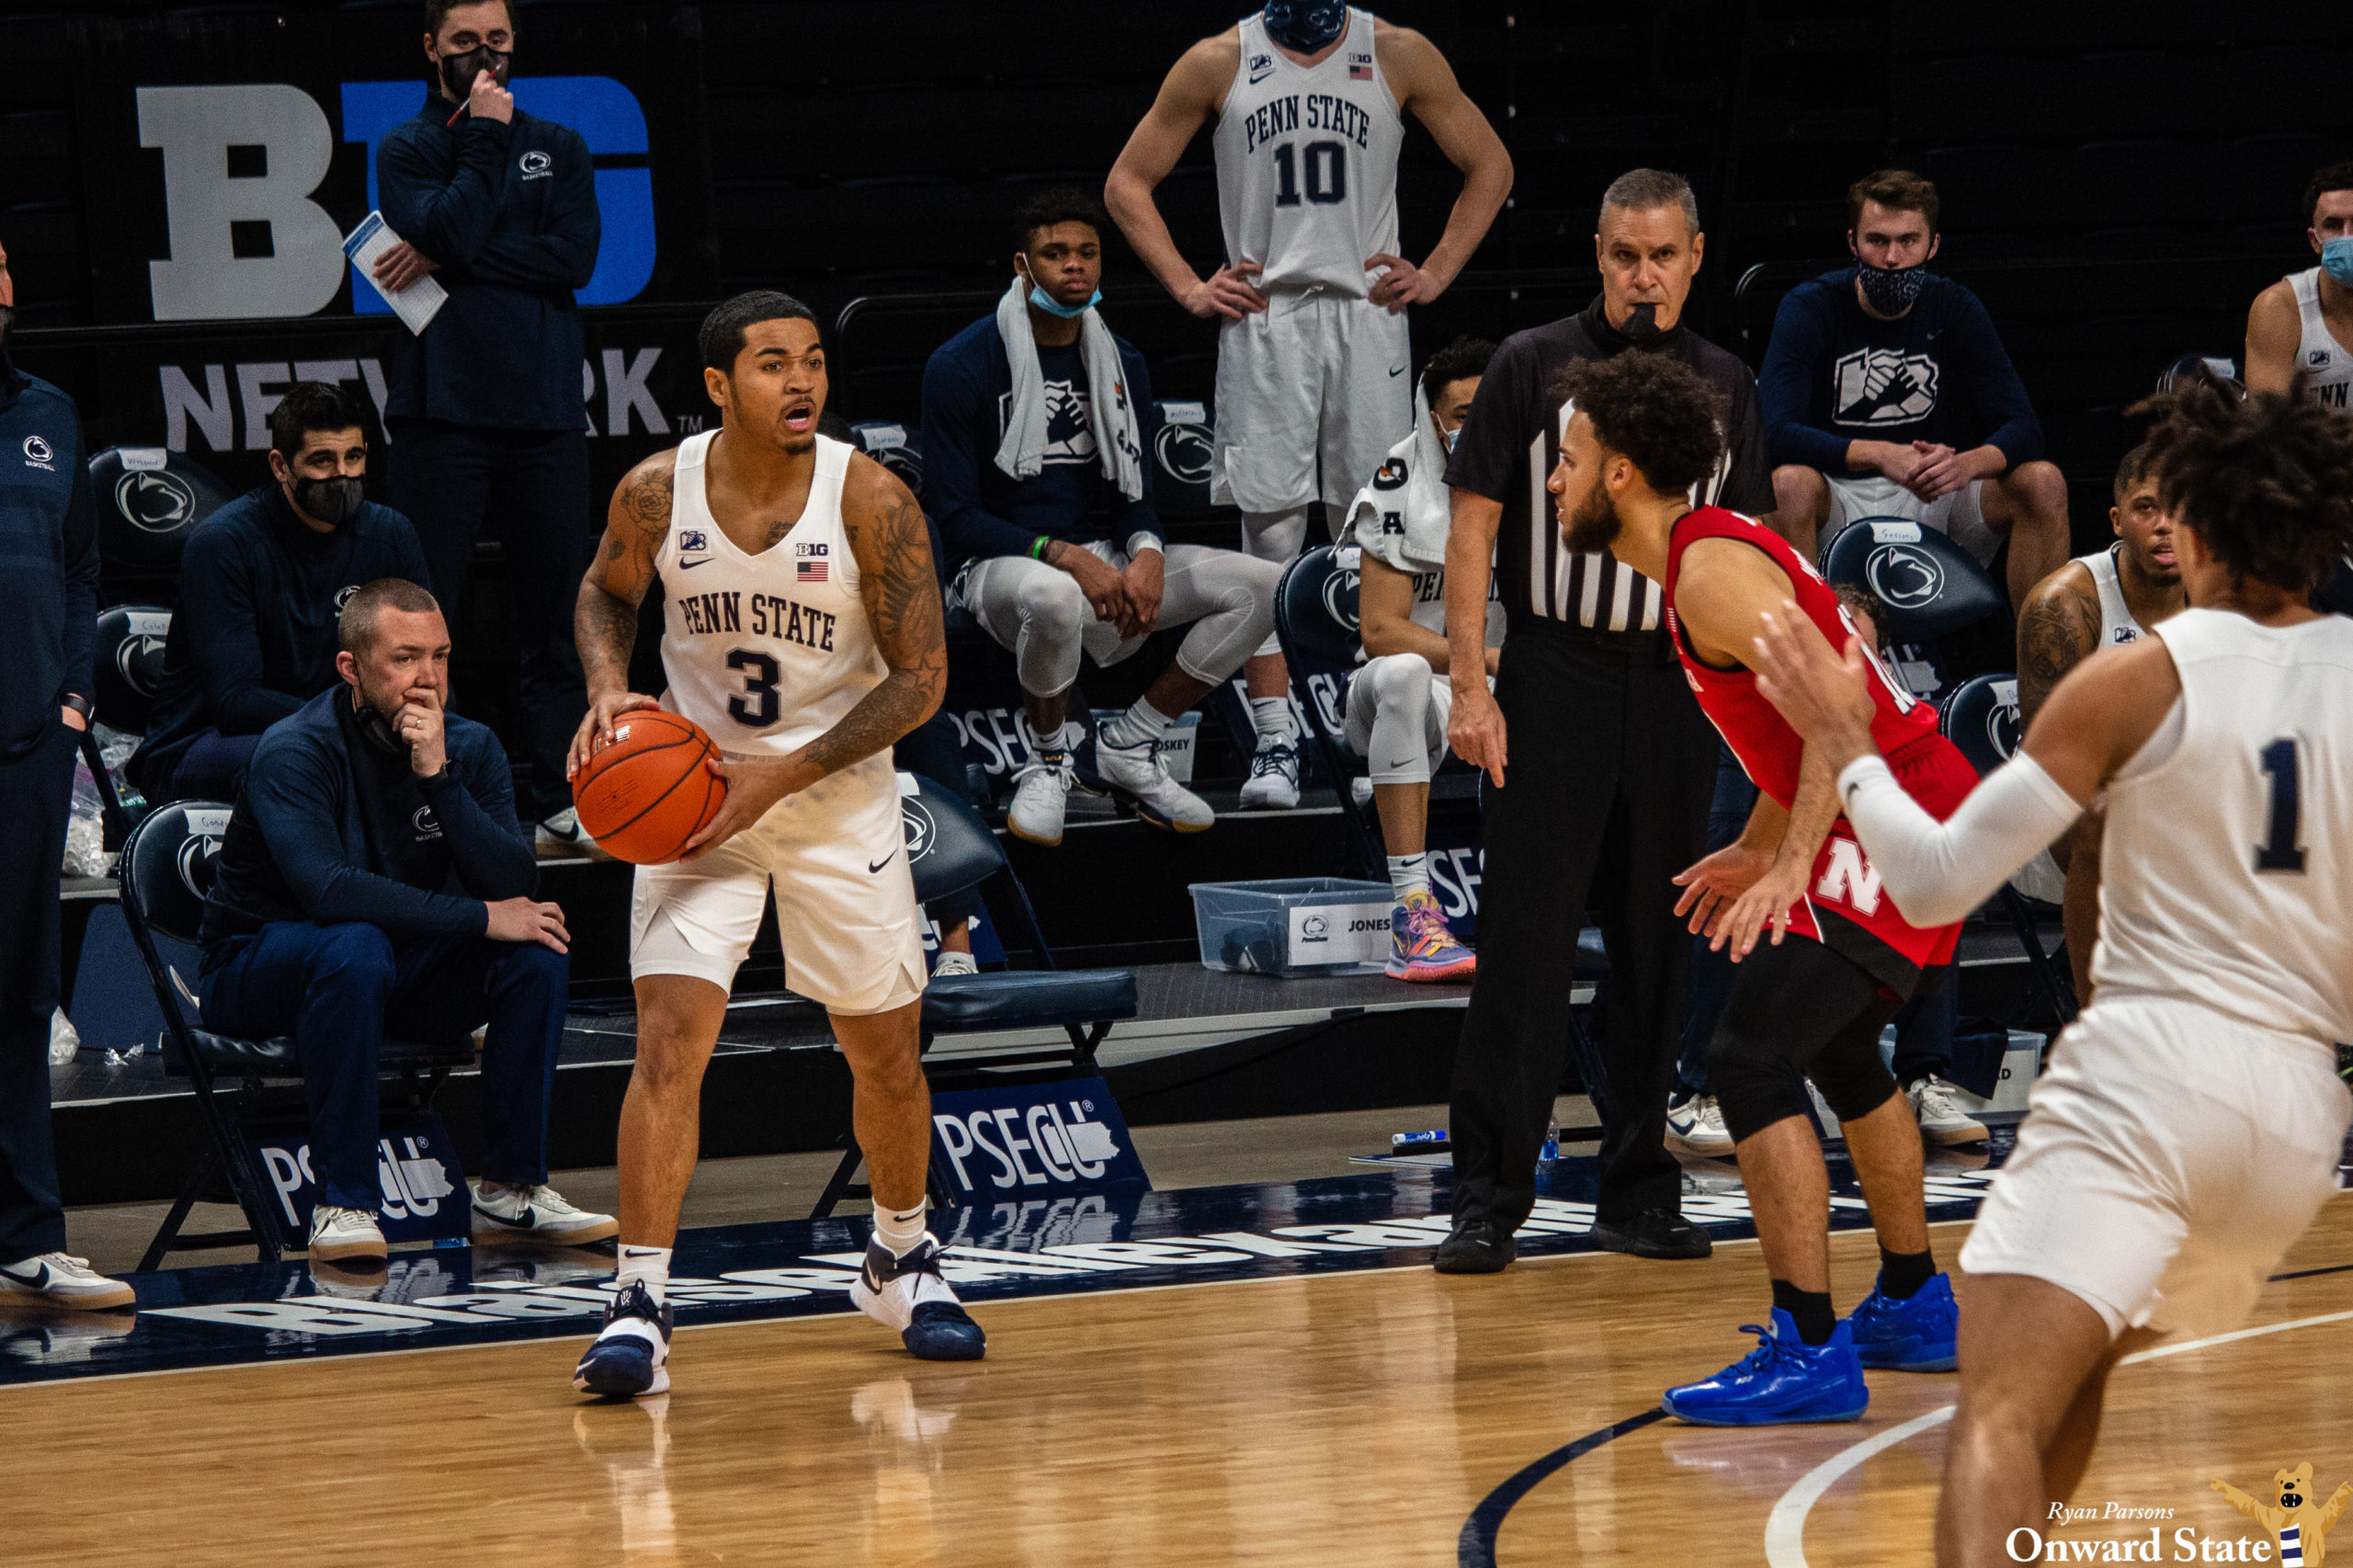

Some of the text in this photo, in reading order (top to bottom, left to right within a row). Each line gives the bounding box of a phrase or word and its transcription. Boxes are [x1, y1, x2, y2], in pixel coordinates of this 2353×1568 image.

[1245, 94, 1370, 154] PENN STATE
[1274, 140, 1347, 208] 10
[678, 591, 836, 653] PENN STATE
[725, 646, 781, 728] 3
[2255, 738, 2309, 874] 1
[1816, 837, 1882, 917] N
[1348, 918, 1391, 932] JONES
[933, 1101, 1106, 1191] PSECU
